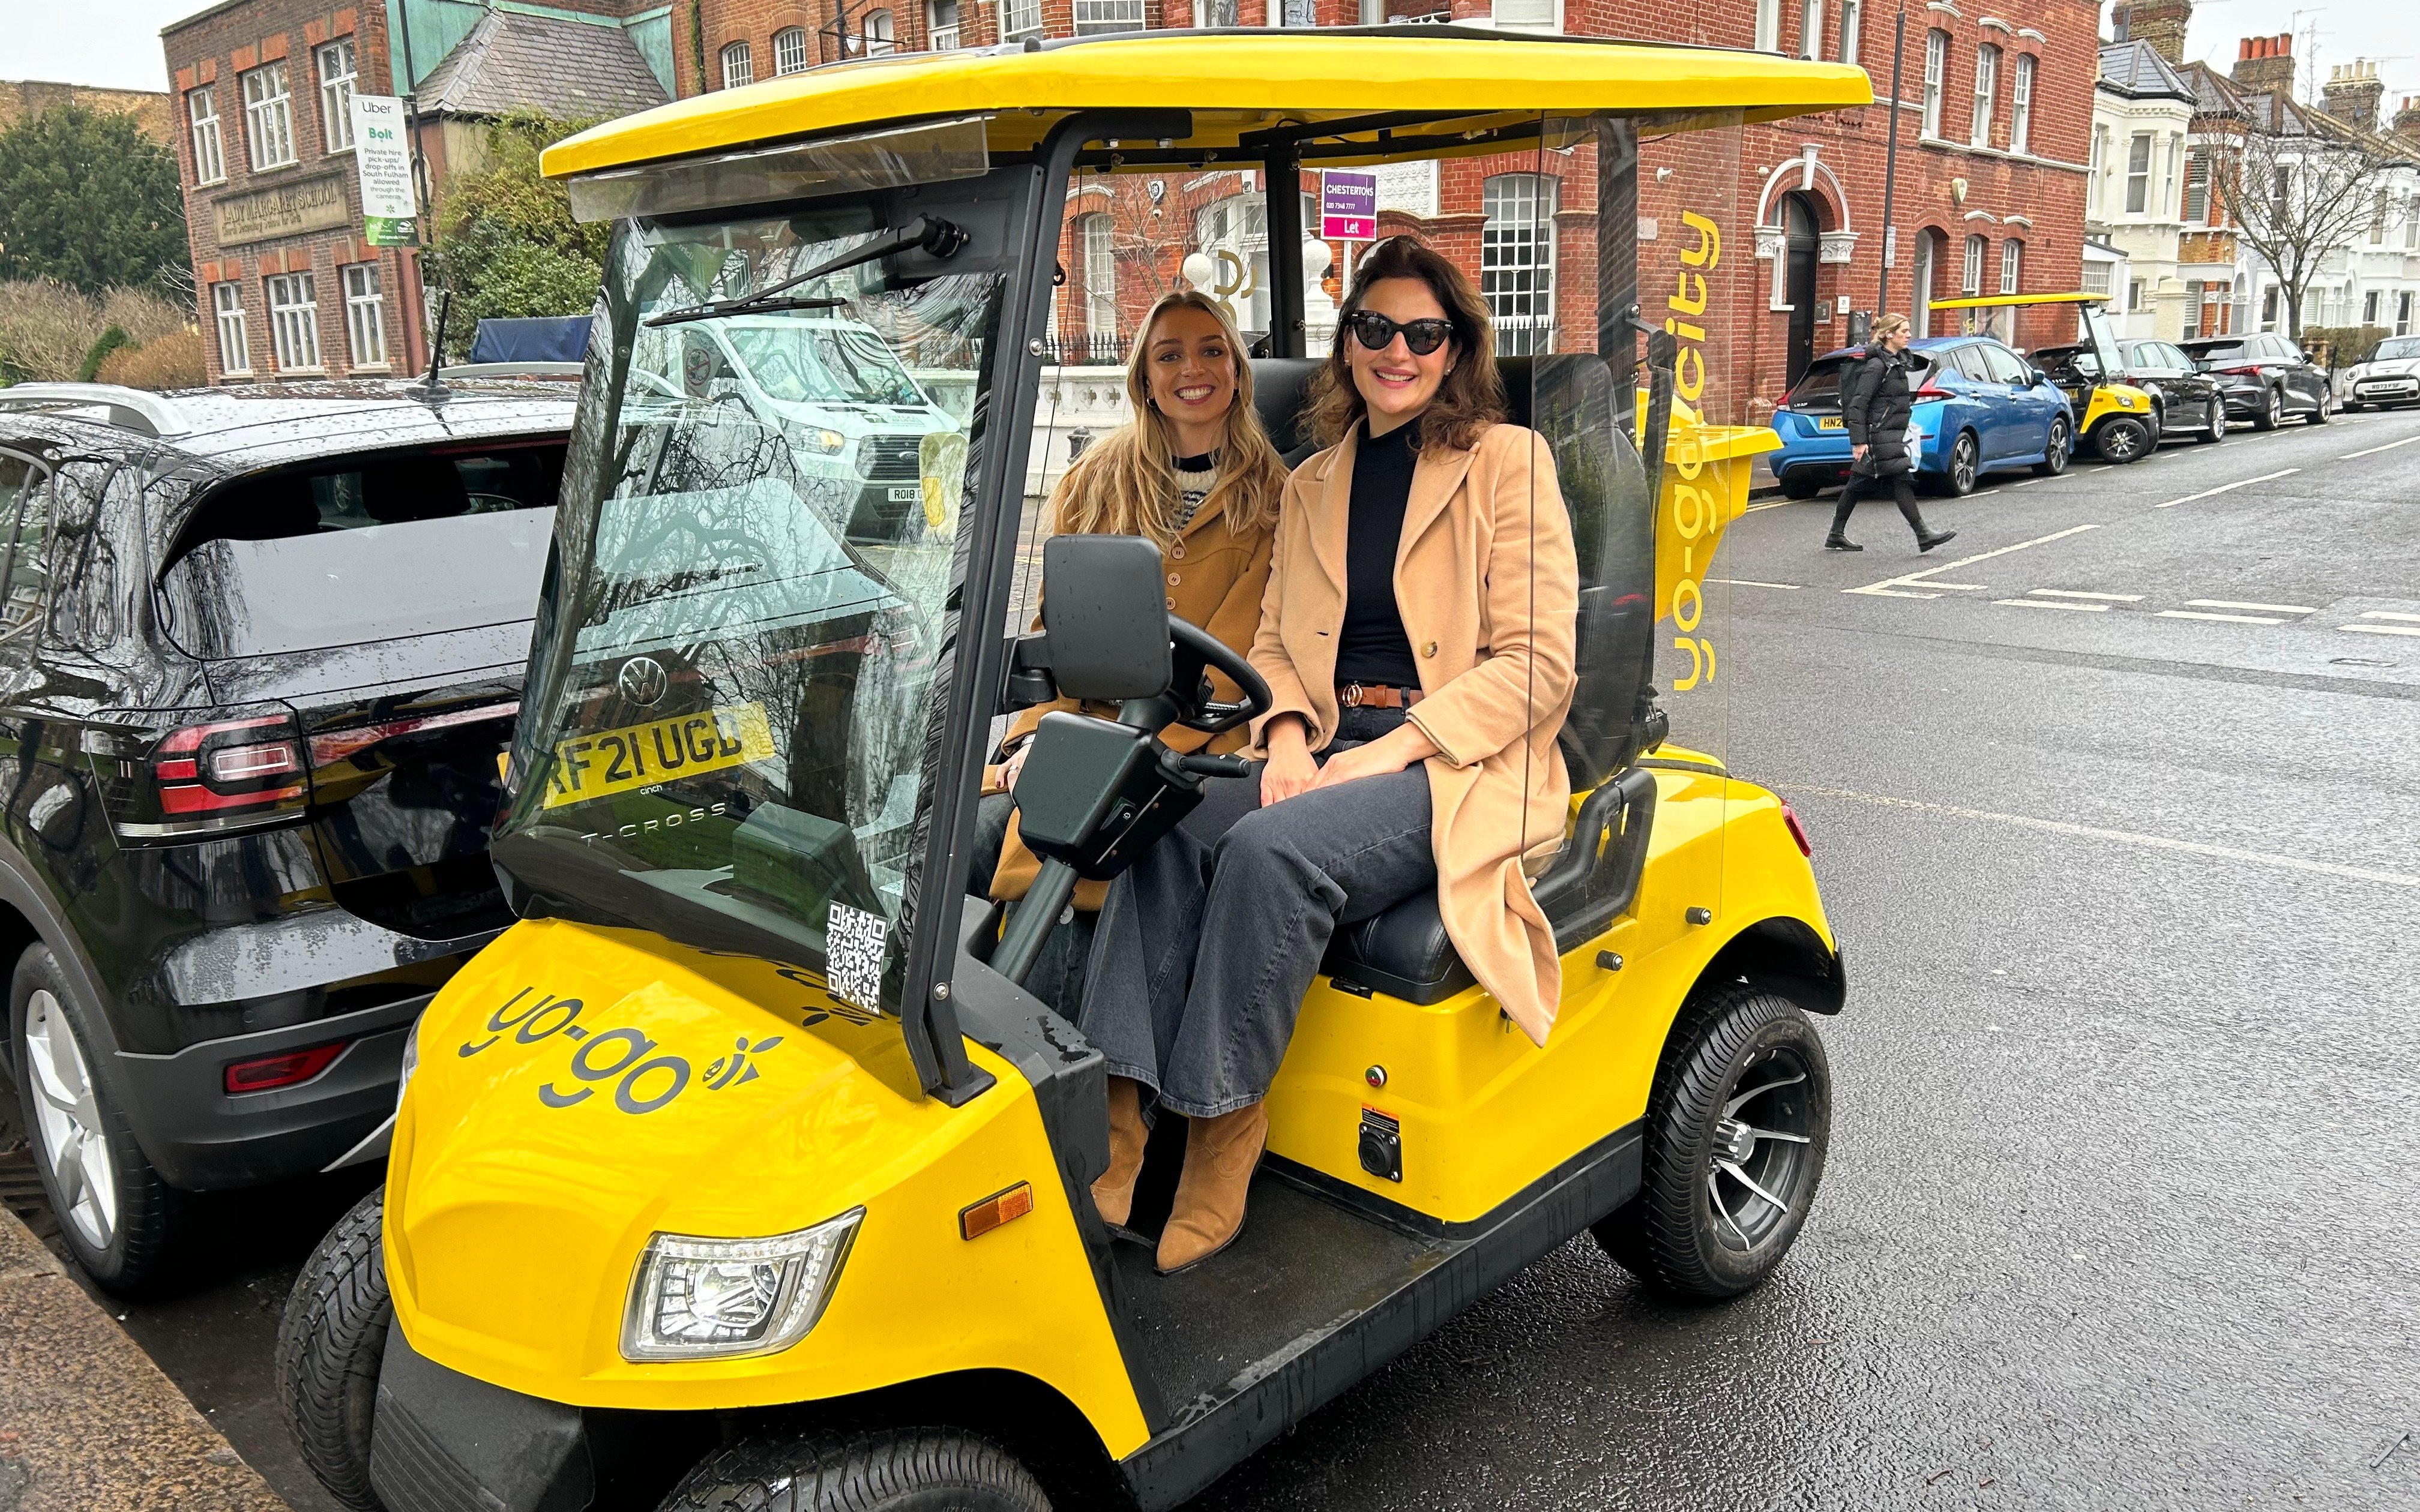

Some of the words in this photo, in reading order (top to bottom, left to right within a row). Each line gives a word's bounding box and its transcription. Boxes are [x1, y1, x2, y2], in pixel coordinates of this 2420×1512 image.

[362, 101, 392, 114] Uber
[368, 127, 393, 140] Bolt
[1326, 185, 1373, 196] CHESTERTONS
[223, 204, 244, 225] LADY
[246, 193, 297, 221] MARGARET
[297, 182, 337, 210] SCHOOL
[1344, 220, 1359, 234] Let
[894, 489, 915, 500] RO18
[640, 784, 663, 796] cinch
[580, 802, 726, 848] T-CROSS
[458, 986, 691, 1115] yo-go
